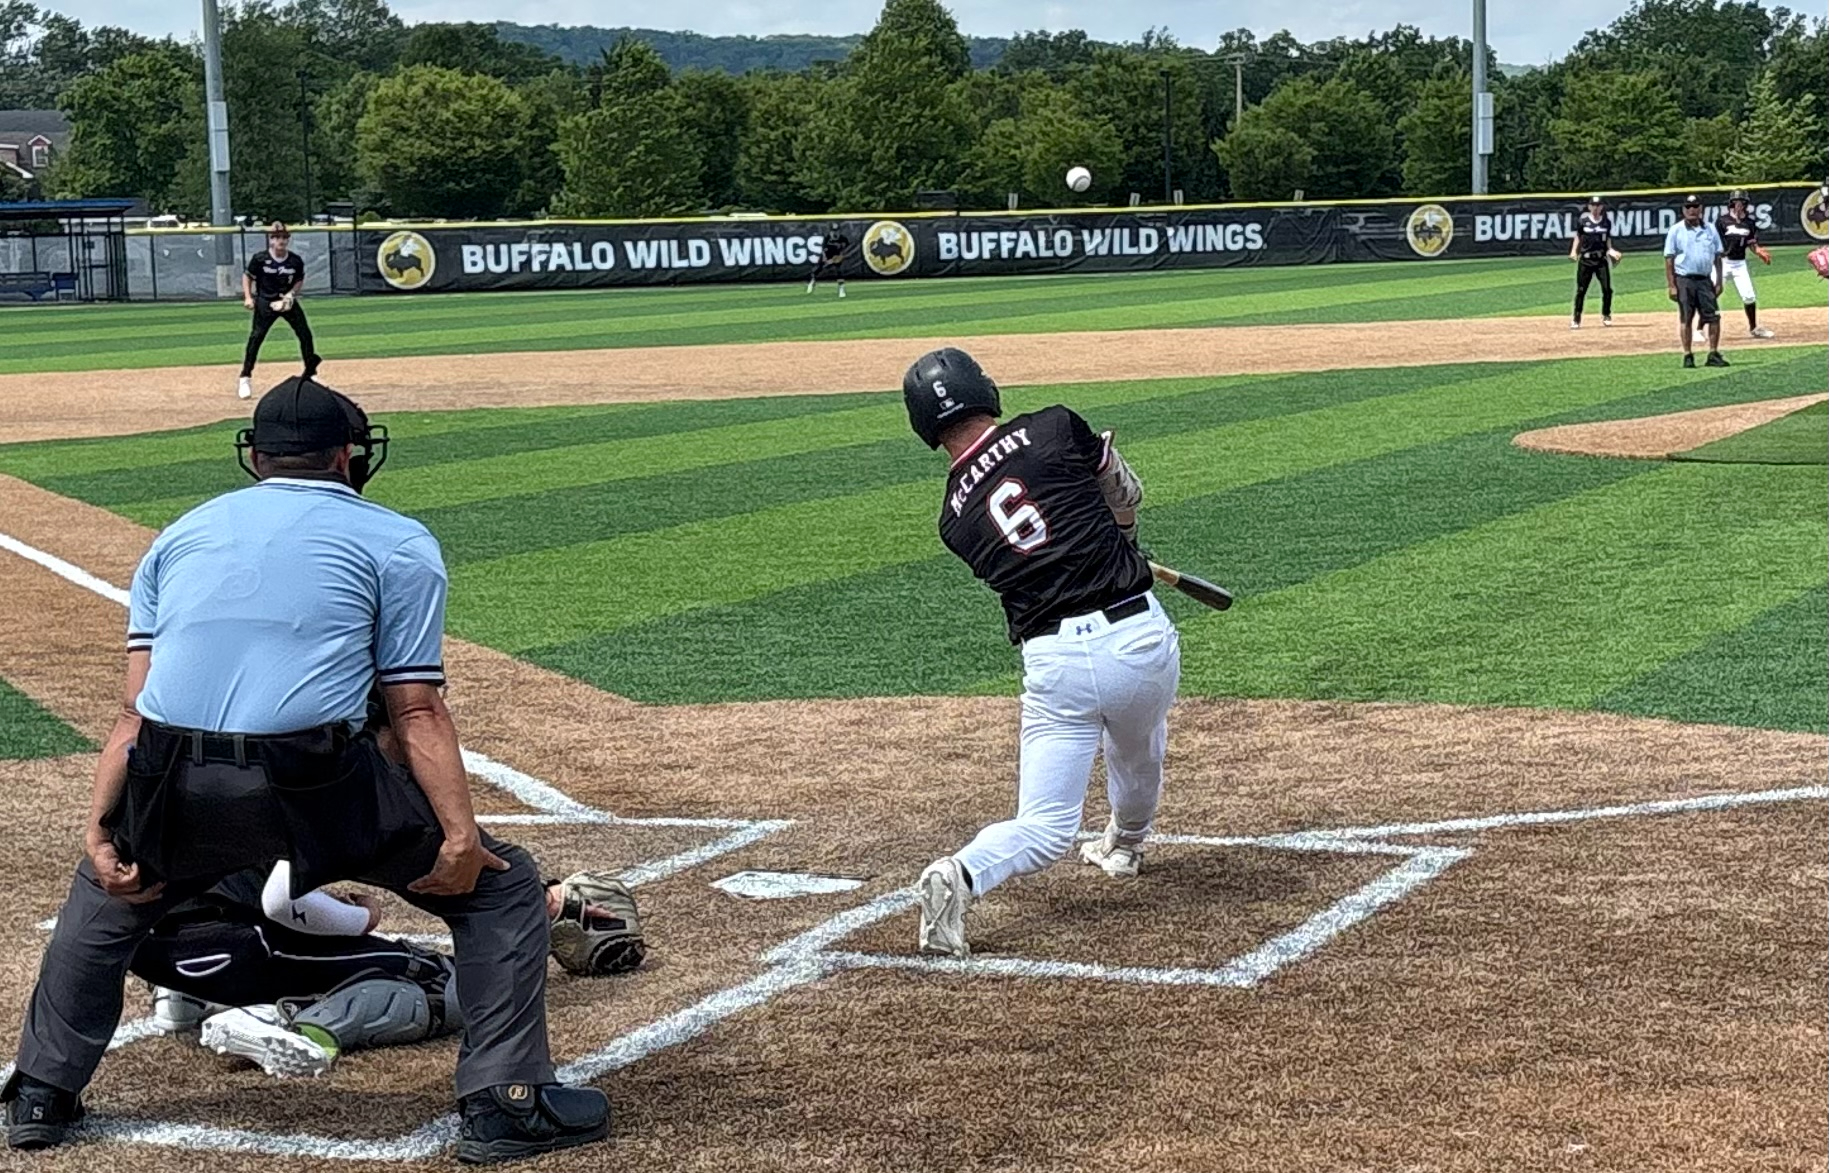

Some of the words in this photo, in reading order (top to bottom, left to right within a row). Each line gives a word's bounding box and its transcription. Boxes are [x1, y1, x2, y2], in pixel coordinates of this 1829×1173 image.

[938, 229, 1073, 260] BUFFALO
[1081, 227, 1159, 256] WILD
[1166, 223, 1263, 253] WINGS
[1474, 211, 1591, 241] BUFFAL
[1605, 208, 1677, 237] WILD
[461, 241, 616, 274] BUFFALO
[623, 239, 711, 269] WILD
[717, 235, 825, 267] WINGS
[932, 380, 947, 398] 6
[950, 427, 1032, 518] McCARTHY
[986, 476, 1051, 556] 6
